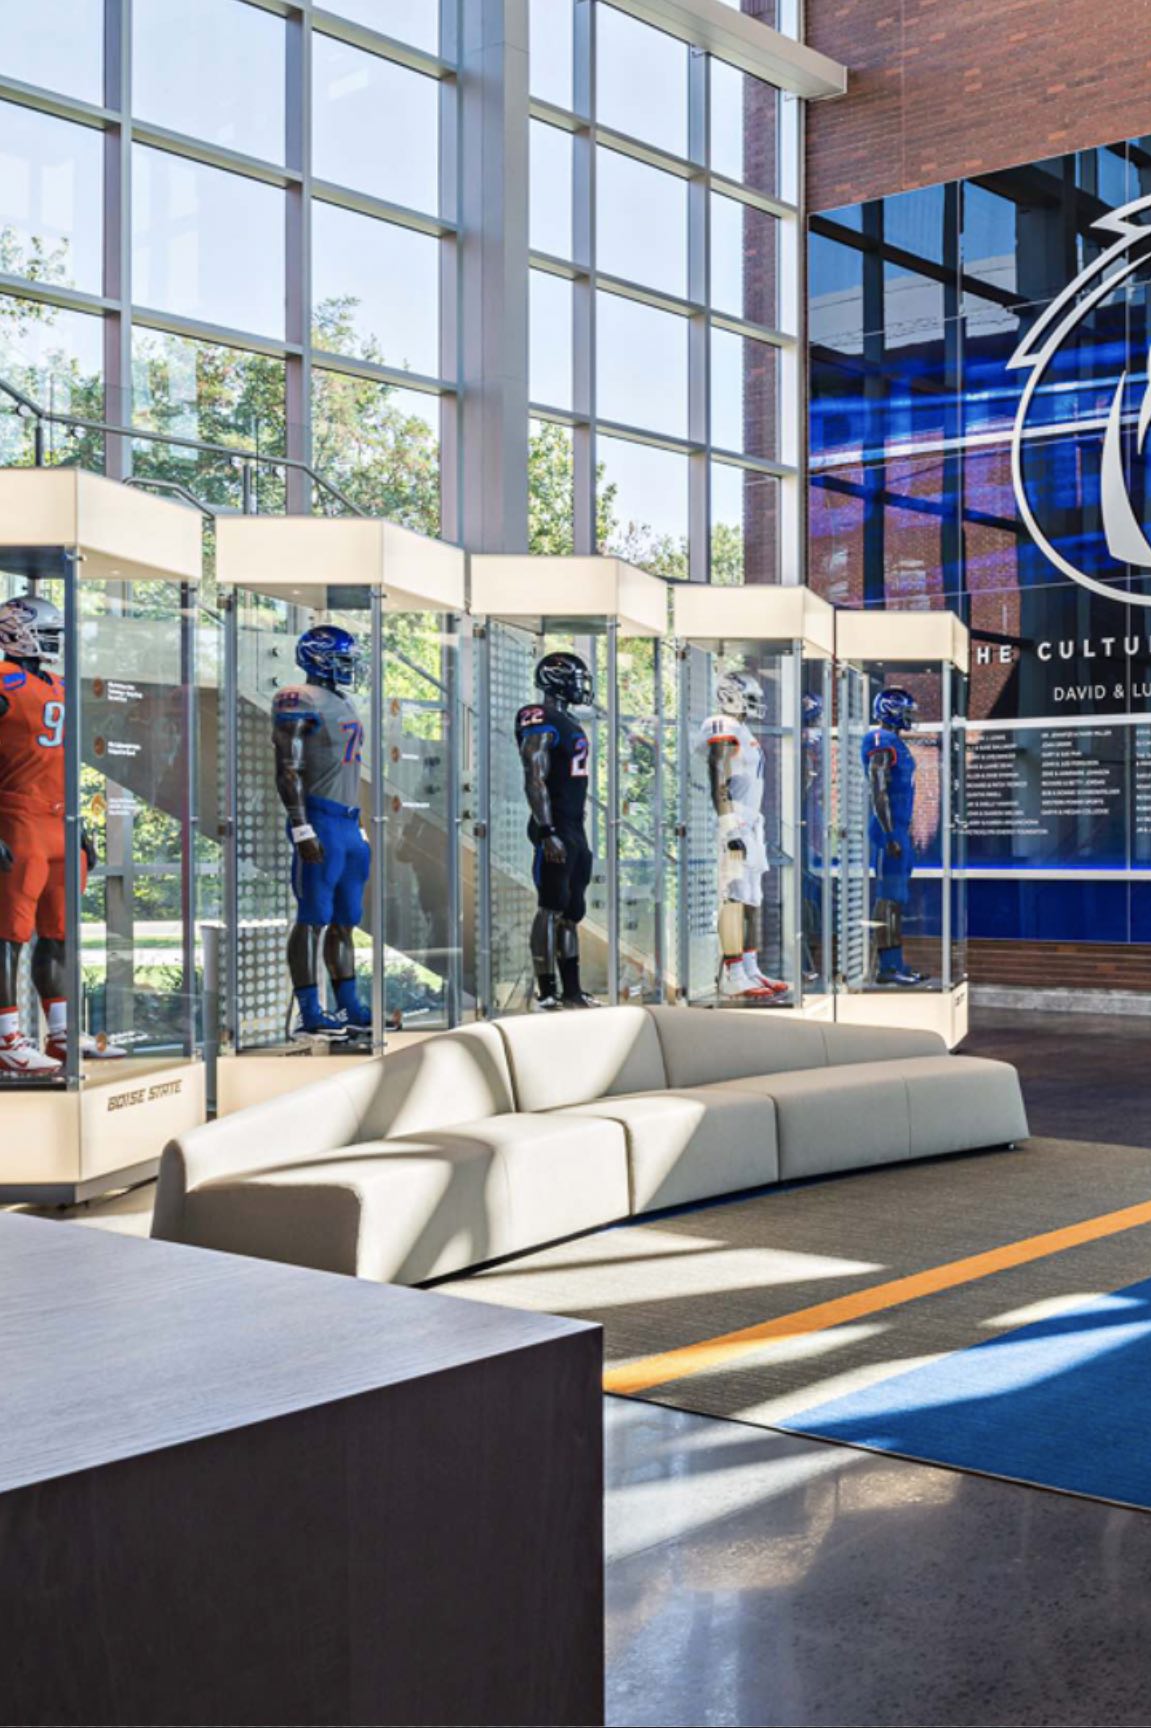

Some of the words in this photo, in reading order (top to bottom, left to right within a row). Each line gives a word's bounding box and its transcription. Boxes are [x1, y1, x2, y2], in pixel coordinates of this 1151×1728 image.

[976, 646, 1012, 665] HE
[1053, 685, 1106, 701] DAVID
[1113, 683, 1125, 699] &
[520, 707, 545, 726] 22
[107, 1088, 146, 1112] BOISE
[147, 1079, 182, 1101] STATE
